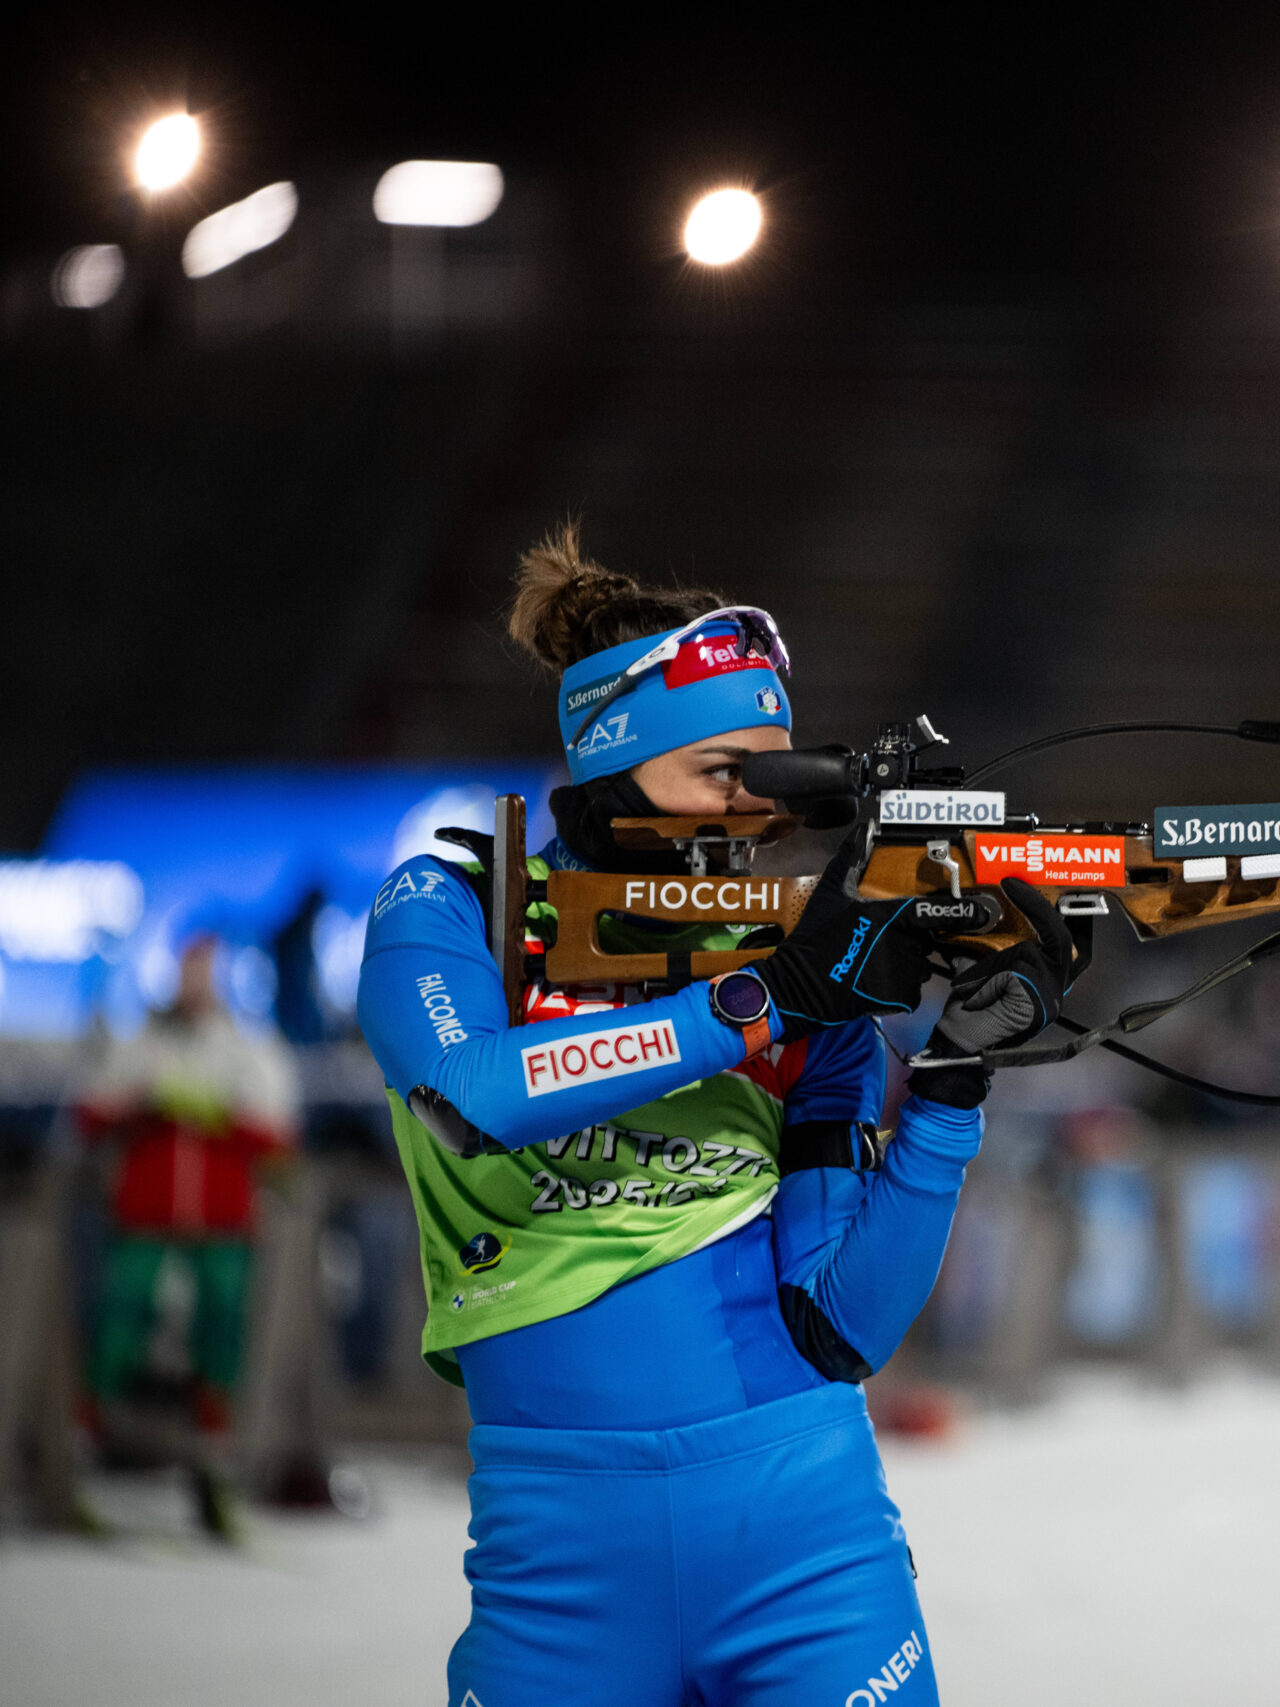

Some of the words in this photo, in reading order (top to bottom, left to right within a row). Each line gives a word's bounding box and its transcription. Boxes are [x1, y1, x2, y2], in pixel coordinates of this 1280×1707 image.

[979, 840, 1121, 872] VIESSMANN
[1045, 870, 1069, 880] Heat
[1071, 872, 1105, 882] pumps
[374, 871, 445, 916] EA7
[625, 881, 780, 911] FIOCCHI
[915, 902, 974, 918] Roeckl
[829, 916, 872, 983] Roeckl
[416, 972, 468, 1053] FALCONER
[526, 1027, 676, 1087] FIOCCHI
[498, 1280, 517, 1292] CUP
